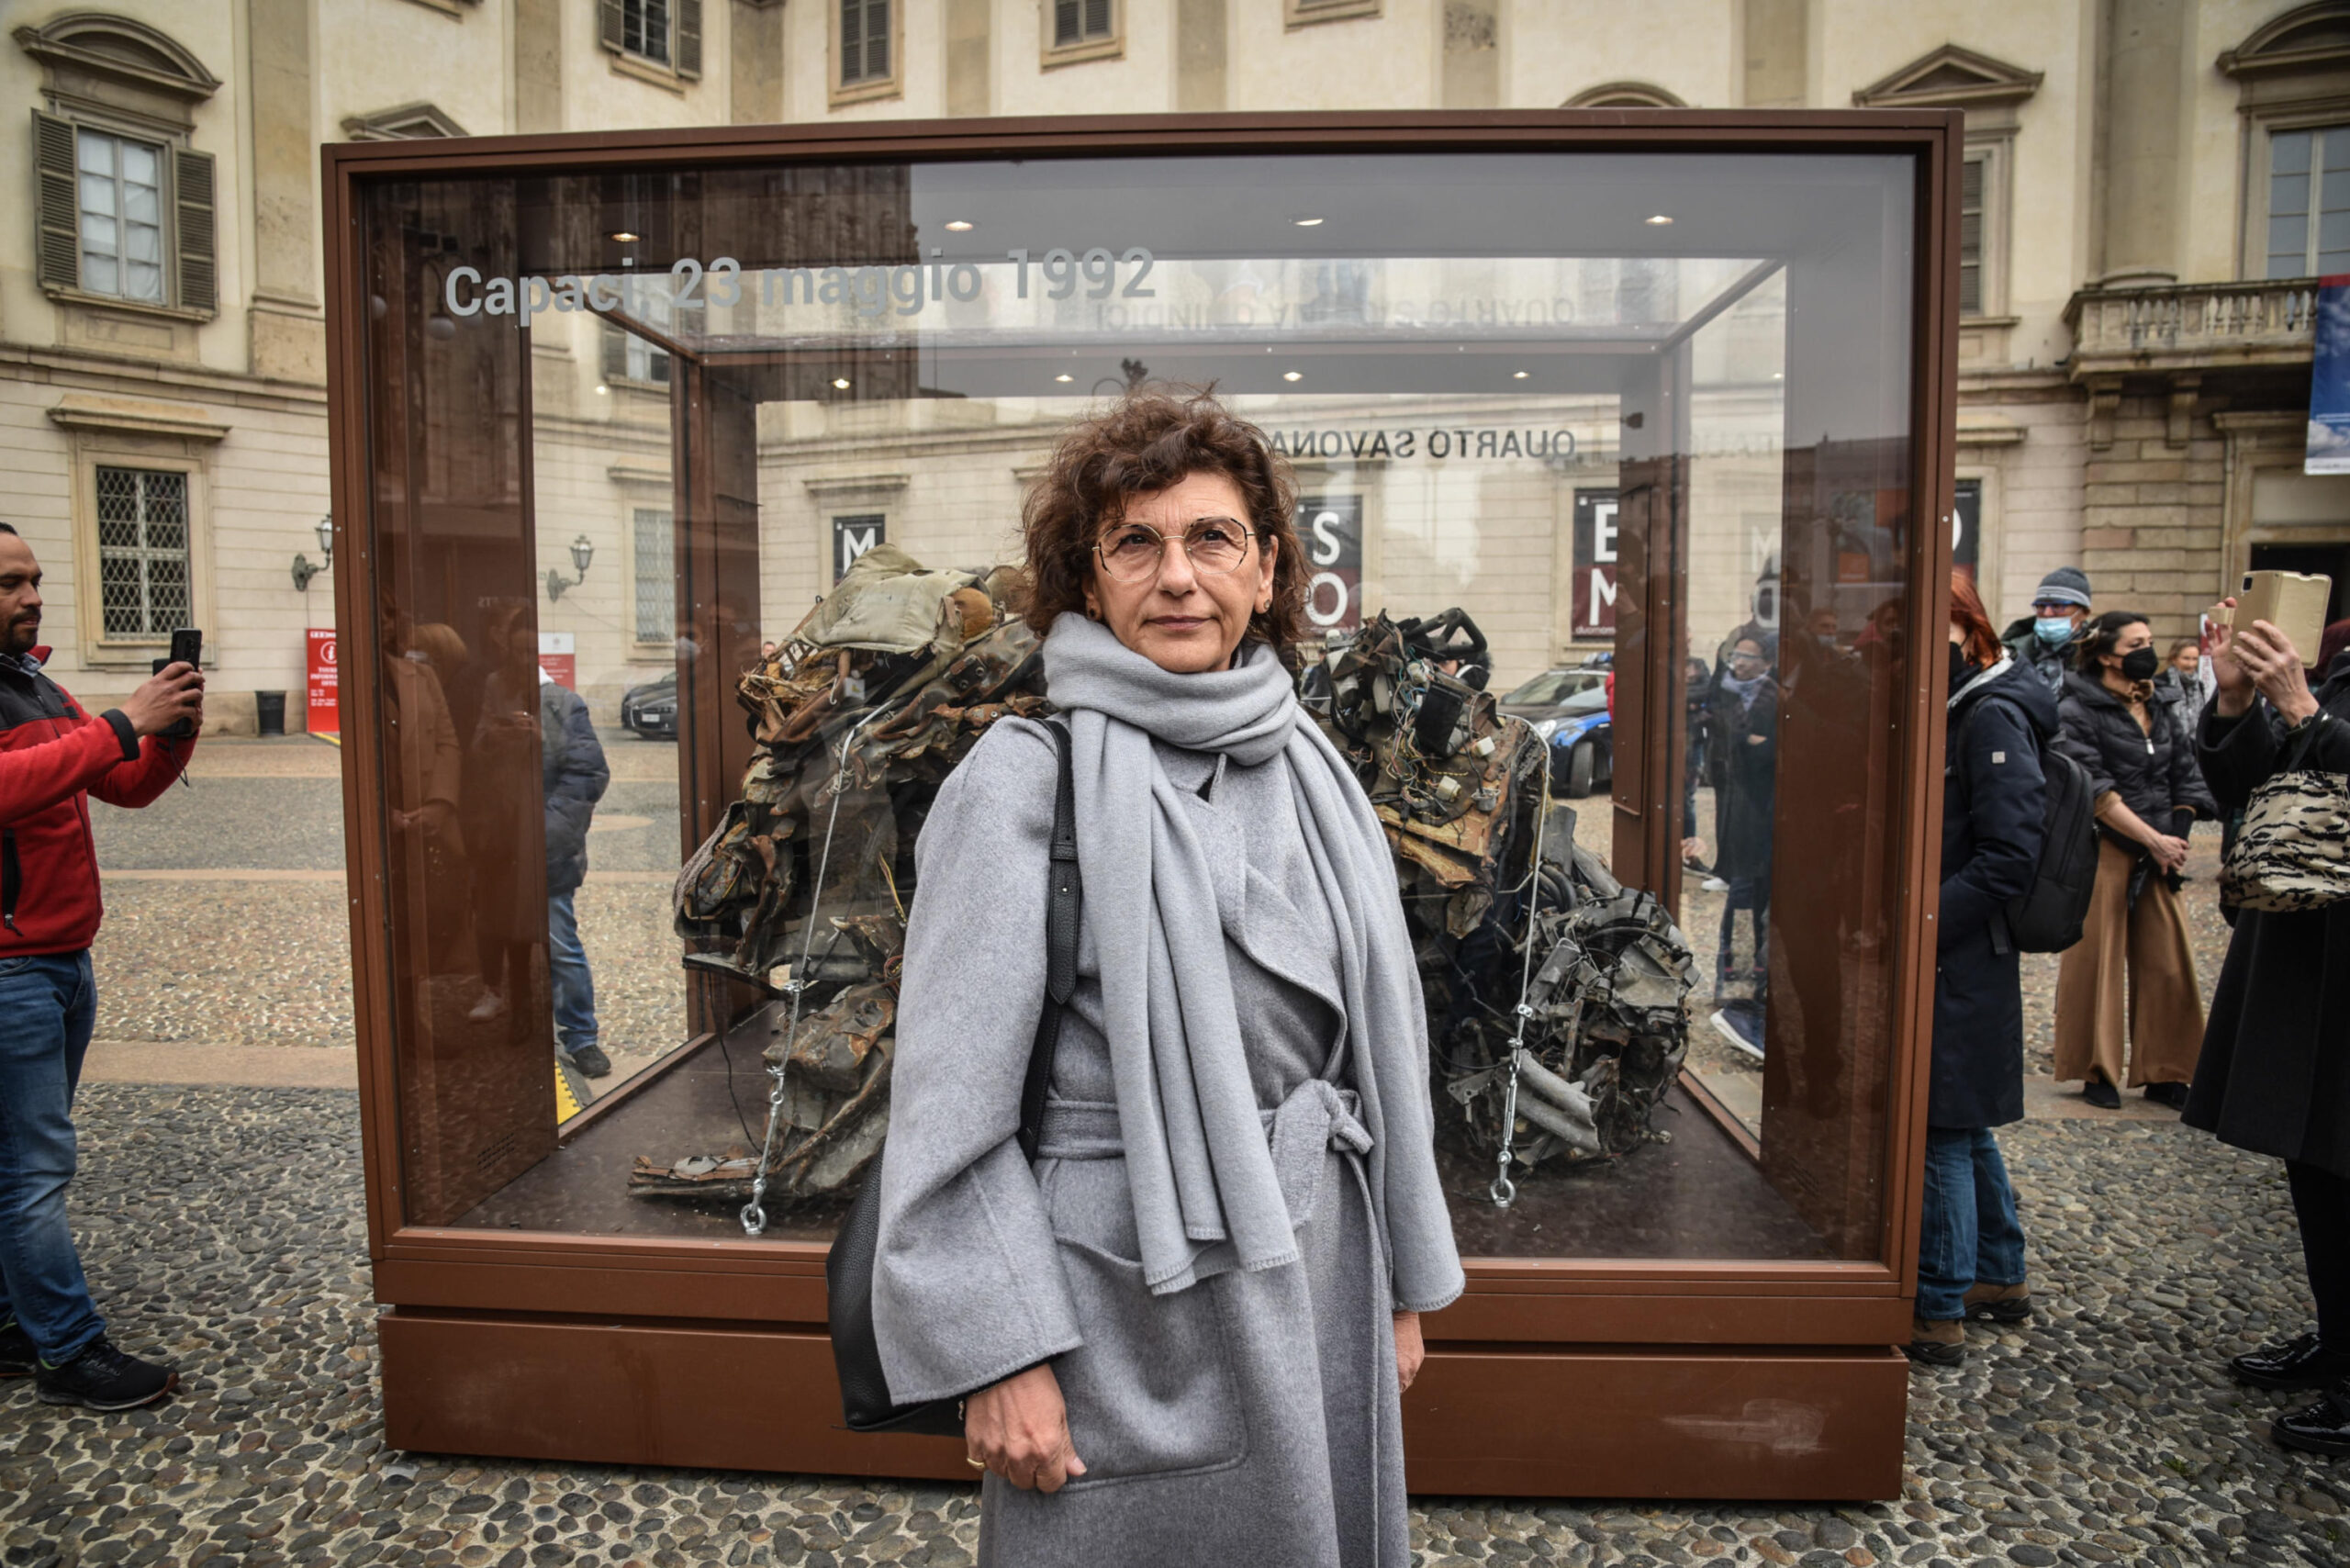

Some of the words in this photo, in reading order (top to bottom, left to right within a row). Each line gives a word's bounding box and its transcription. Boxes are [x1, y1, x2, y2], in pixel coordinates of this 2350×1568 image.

[444, 257, 650, 329] Capaci,
[671, 256, 741, 309] 23
[763, 248, 981, 317] maggio
[1006, 246, 1156, 300] 1992
[843, 527, 876, 574] M
[1313, 510, 1340, 566] S
[1595, 503, 1618, 562] E
[1304, 572, 1348, 626] O
[1575, 625, 1617, 635] duomom
